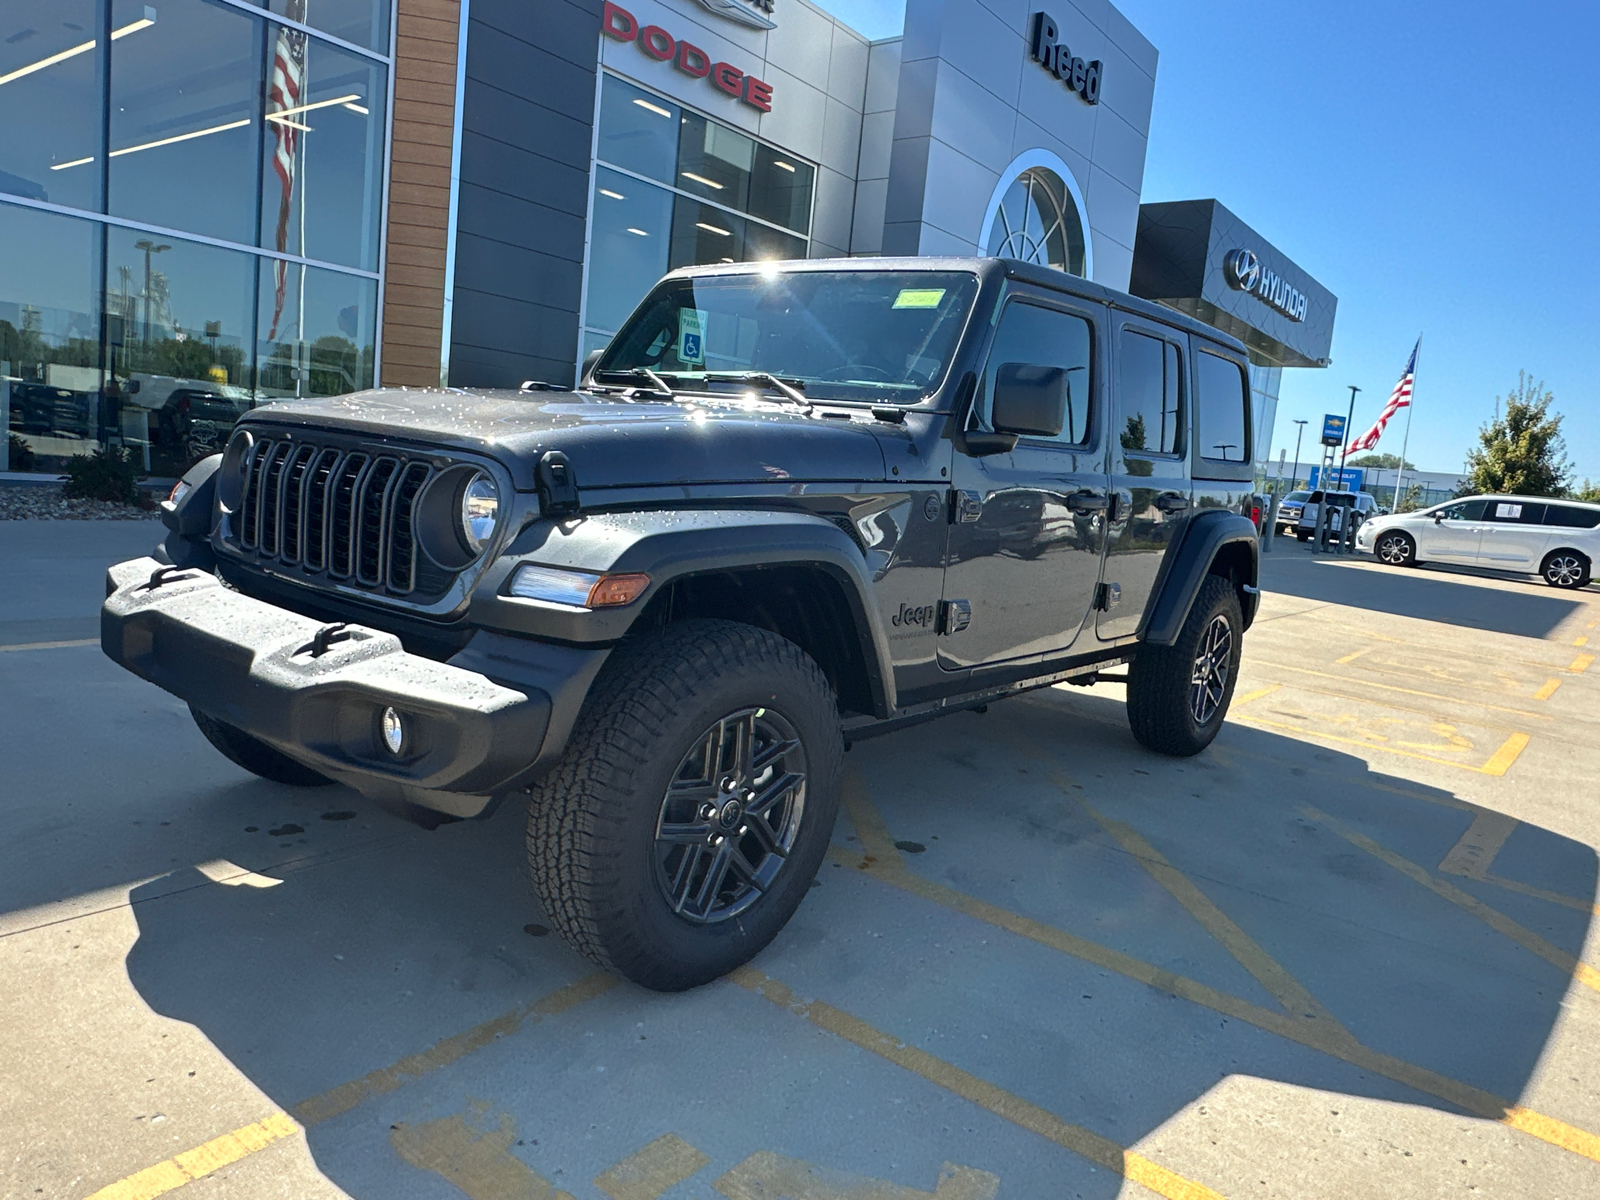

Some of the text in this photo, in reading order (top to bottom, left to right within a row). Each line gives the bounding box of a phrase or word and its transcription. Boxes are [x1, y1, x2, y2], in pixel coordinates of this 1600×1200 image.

[601, 0, 773, 112] DODGE
[1033, 11, 1103, 105] Reed
[1259, 266, 1308, 322] HYUNDAI
[892, 603, 934, 627] Jeep
